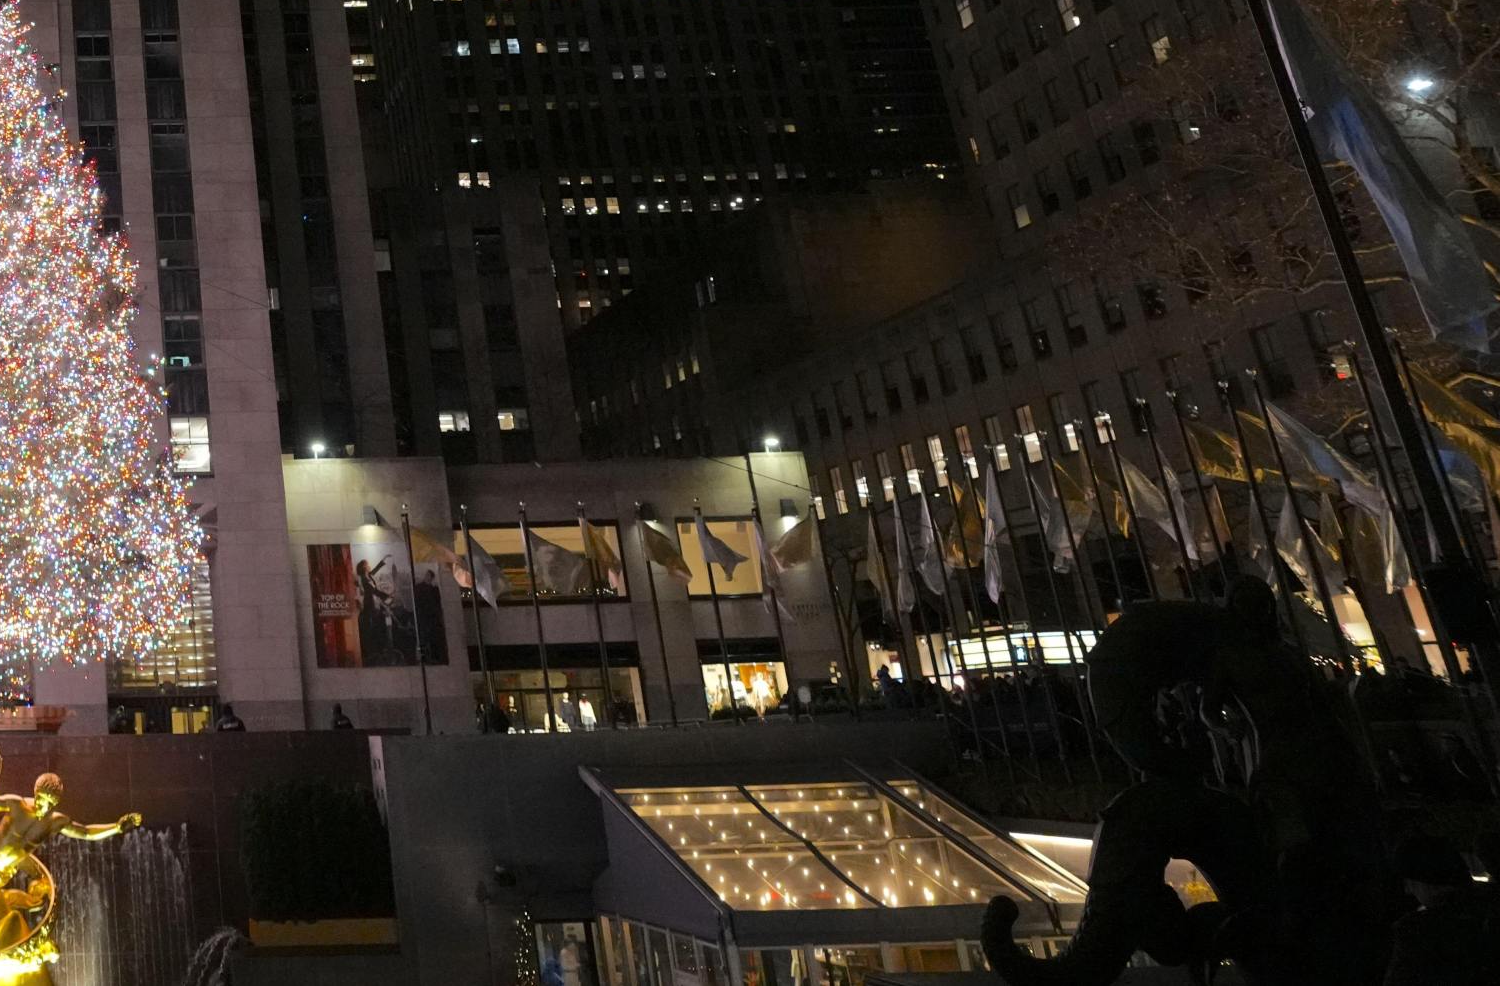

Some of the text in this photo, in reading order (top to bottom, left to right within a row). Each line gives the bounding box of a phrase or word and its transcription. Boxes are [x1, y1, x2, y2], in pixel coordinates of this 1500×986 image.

[320, 594, 345, 602] TOP OF
[317, 601, 350, 609] THE ROCK
